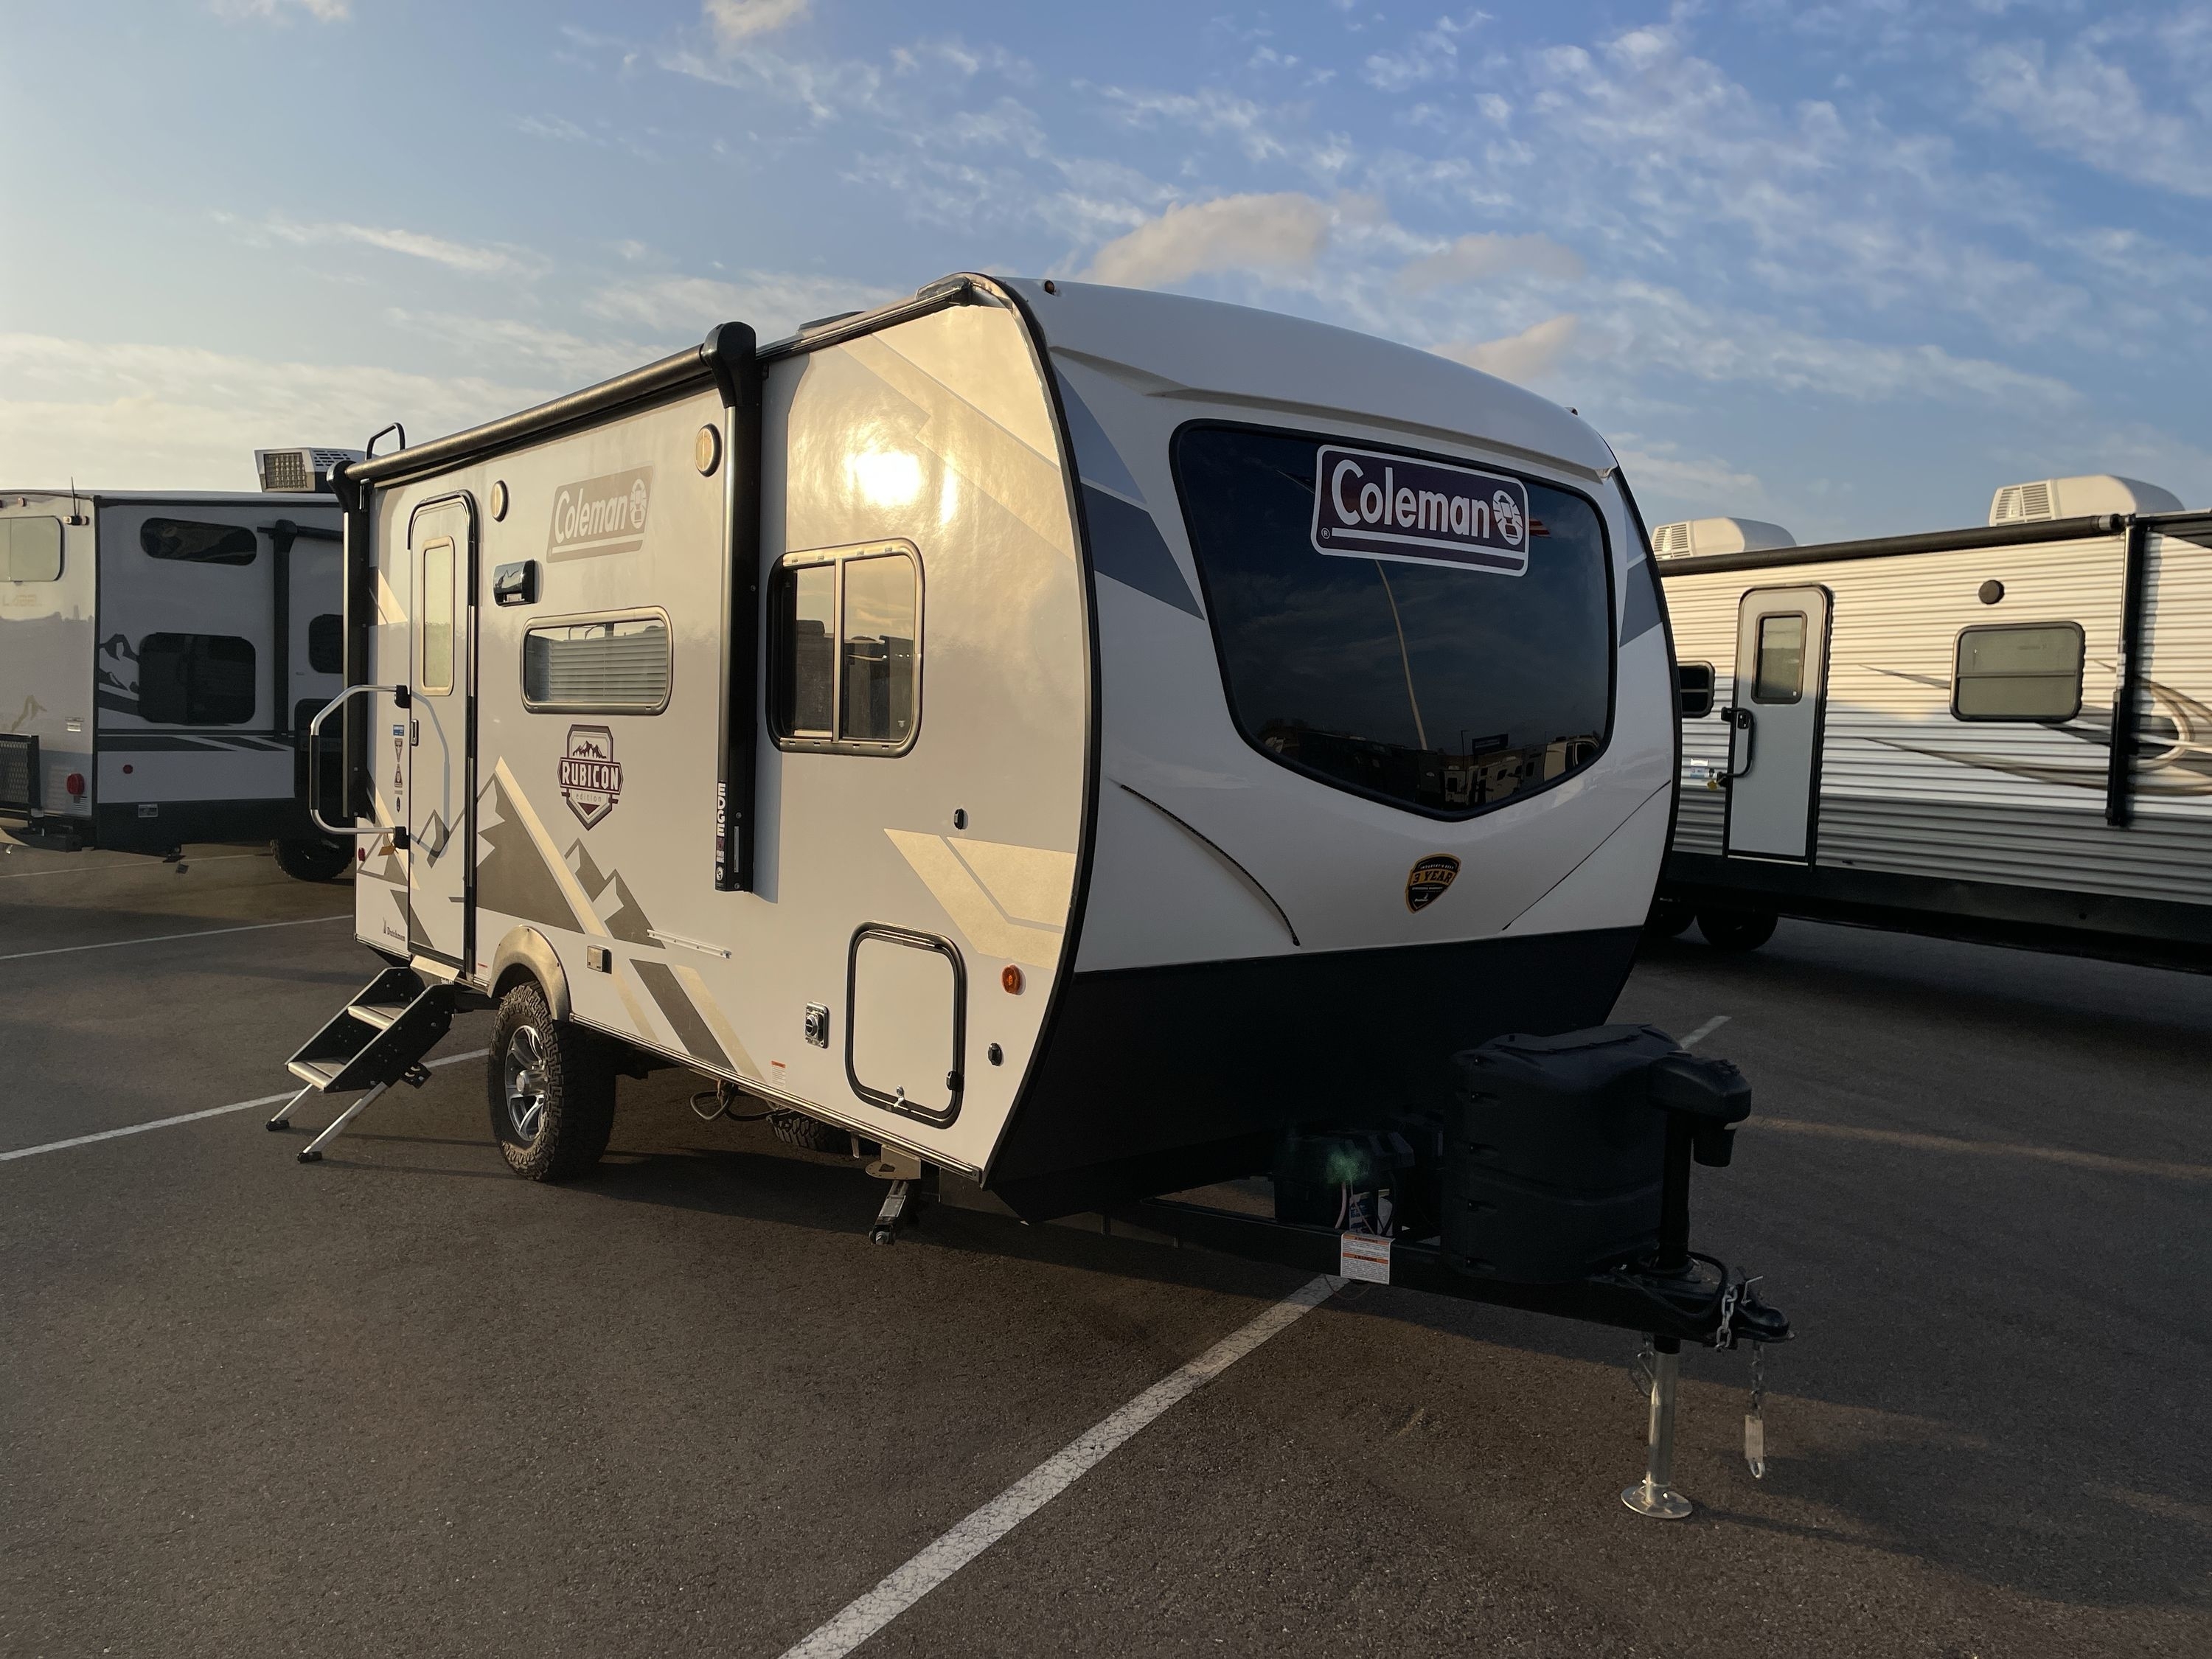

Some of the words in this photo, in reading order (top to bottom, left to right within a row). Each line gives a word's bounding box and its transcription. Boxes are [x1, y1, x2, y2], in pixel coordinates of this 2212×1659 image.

[554, 487, 627, 543] Coleman
[1331, 459, 1490, 539] Coleman
[562, 761, 619, 790] RUBICON
[575, 792, 602, 802] edition
[717, 782, 726, 837] EDGE
[1413, 873, 1421, 883] 3
[1425, 870, 1453, 883] YEAR
